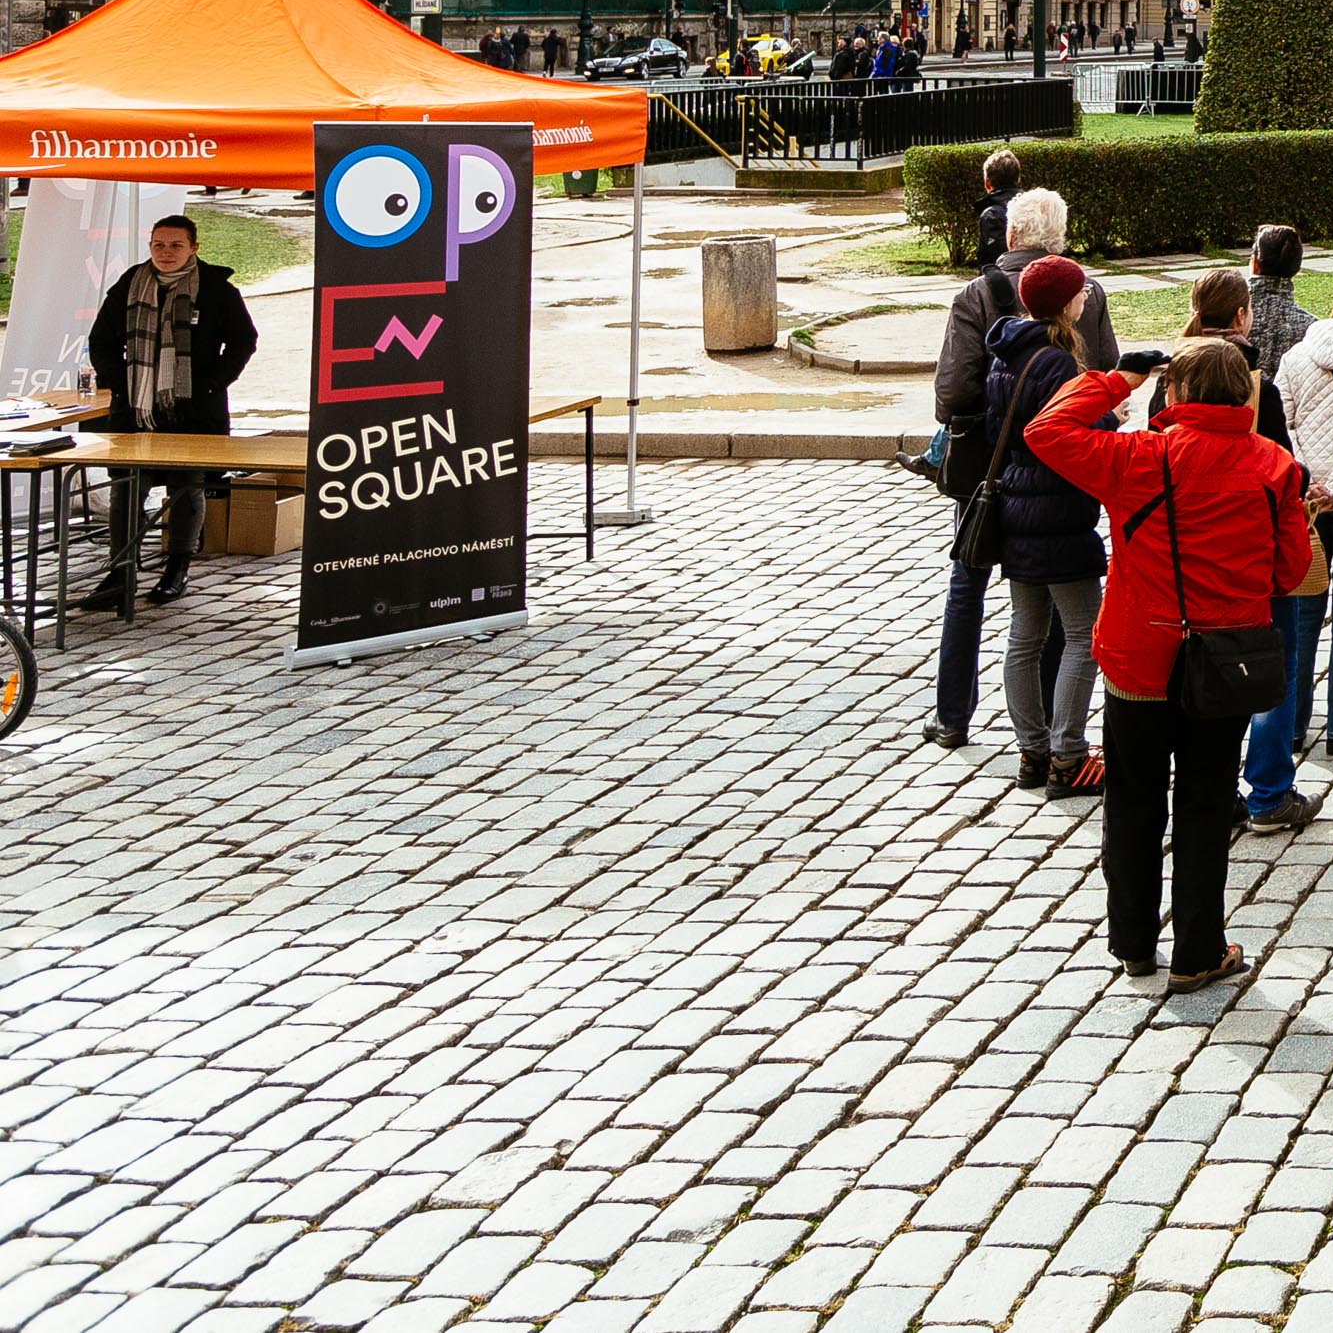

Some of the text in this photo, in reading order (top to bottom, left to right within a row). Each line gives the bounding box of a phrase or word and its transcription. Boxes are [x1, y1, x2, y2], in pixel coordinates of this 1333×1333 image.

[28, 130, 220, 163] filharmonie
[316, 408, 457, 474] OPEN
[318, 438, 518, 521] SQUARE
[314, 536, 514, 574] OTEVŘENÉ PALACHOVO NÁMĚSTÍ
[430, 596, 461, 609] u(p)m
